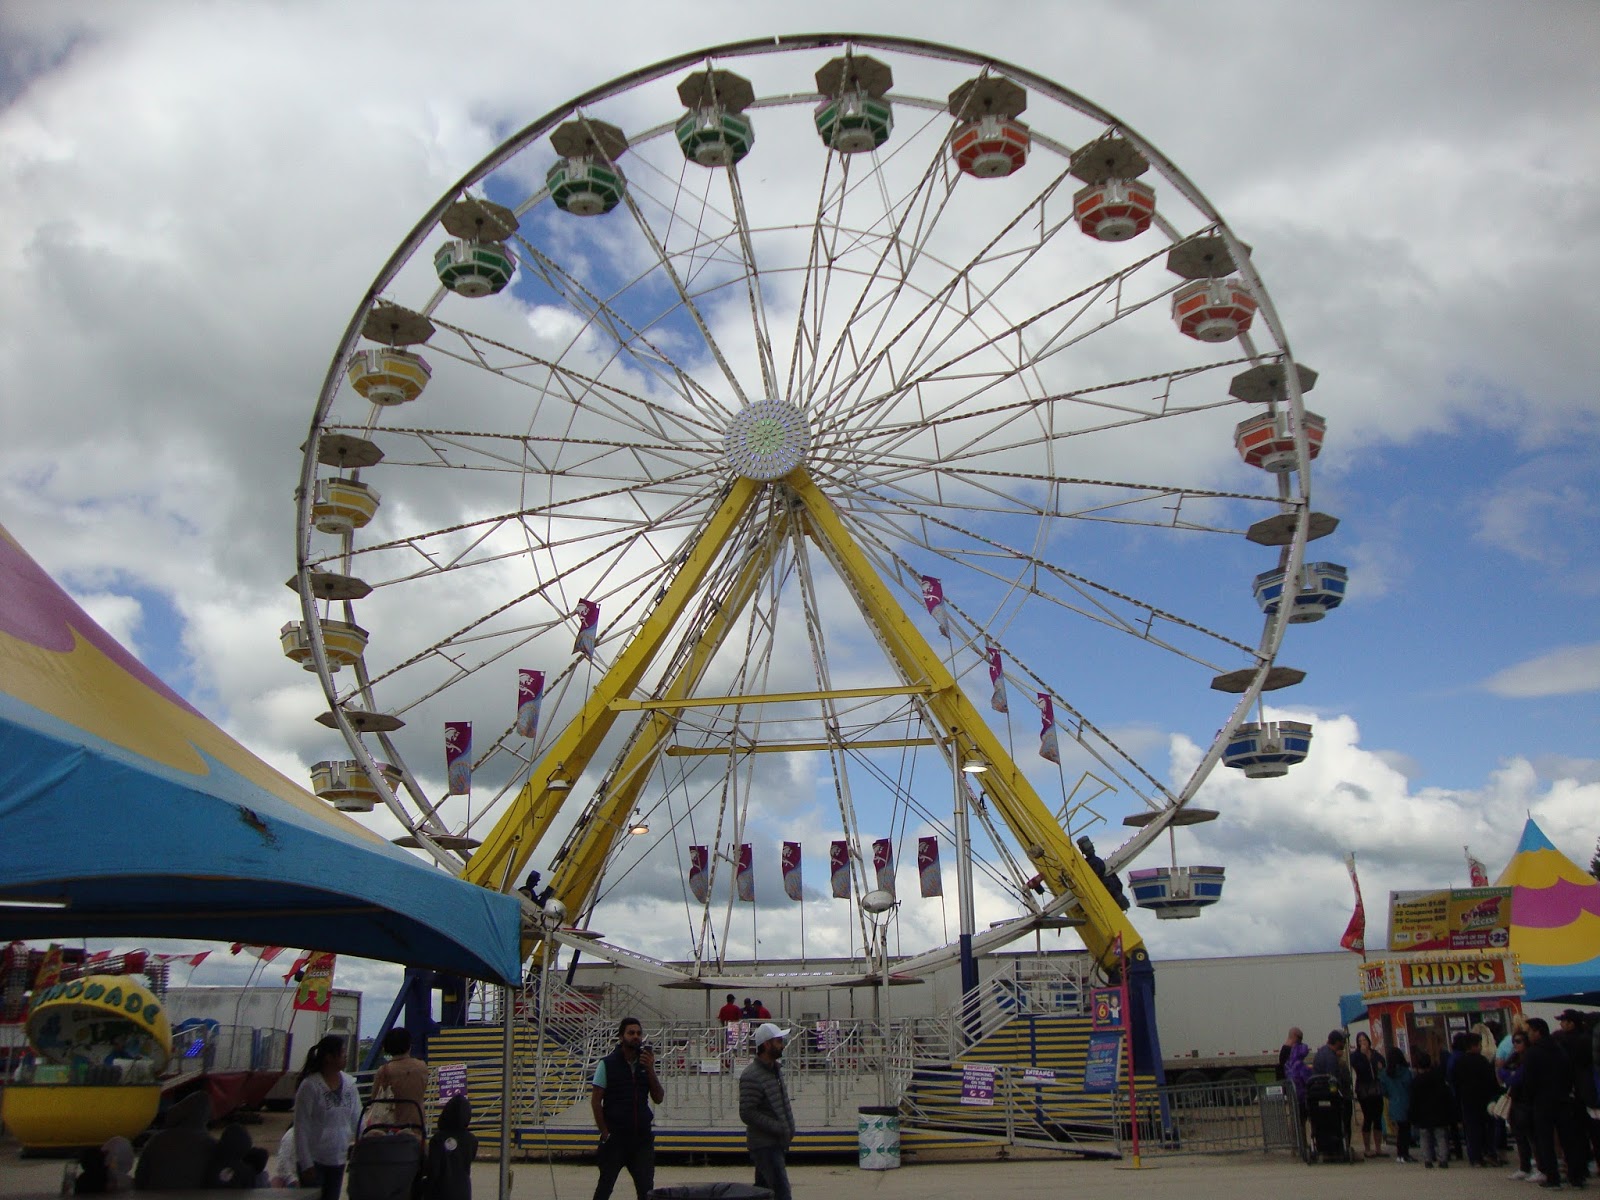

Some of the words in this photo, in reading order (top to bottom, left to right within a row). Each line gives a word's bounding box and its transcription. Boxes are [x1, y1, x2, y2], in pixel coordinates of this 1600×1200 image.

[1410, 960, 1496, 986] RIDES
[1098, 1004, 1107, 1017] 6
[1025, 1069, 1054, 1077] ENTRANCE
